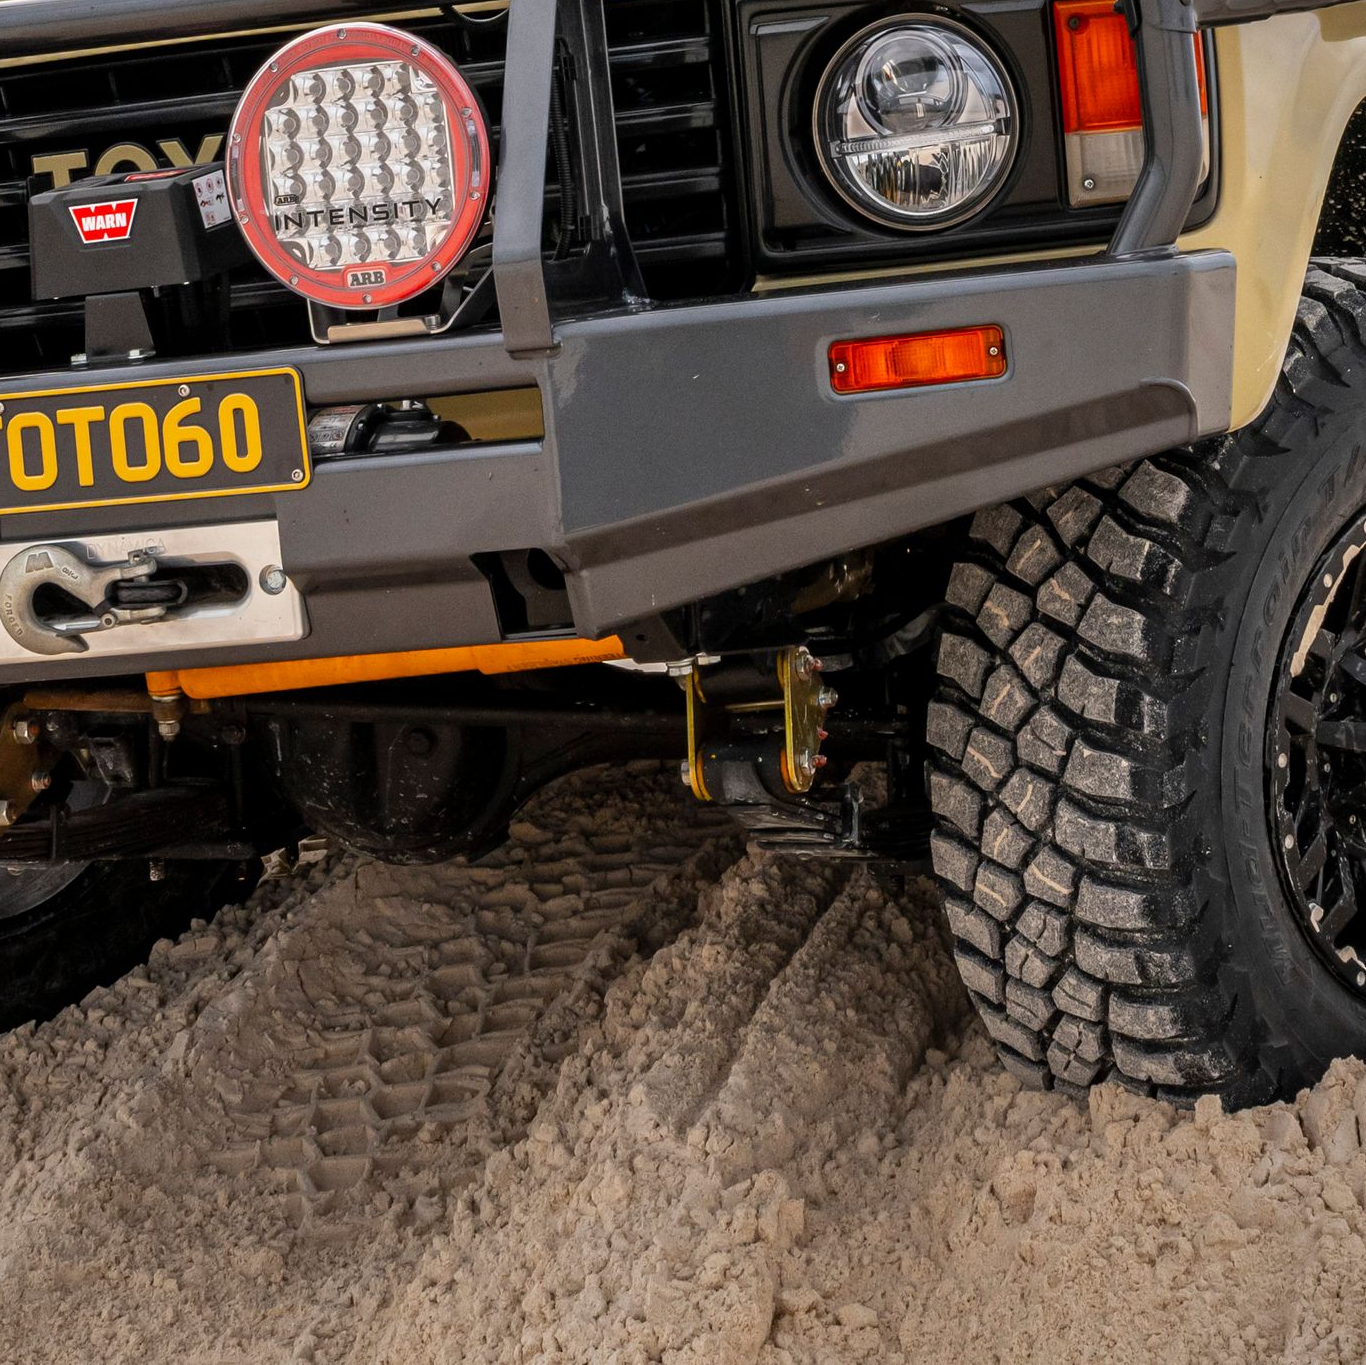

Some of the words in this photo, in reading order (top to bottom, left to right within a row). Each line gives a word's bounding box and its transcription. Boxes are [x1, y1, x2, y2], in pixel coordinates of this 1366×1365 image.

[32, 133, 225, 190] TOY
[81, 212, 127, 232] WARN
[274, 197, 443, 232] INTENSITY
[350, 270, 385, 286] ARB
[4, 594, 24, 637] FORGED
